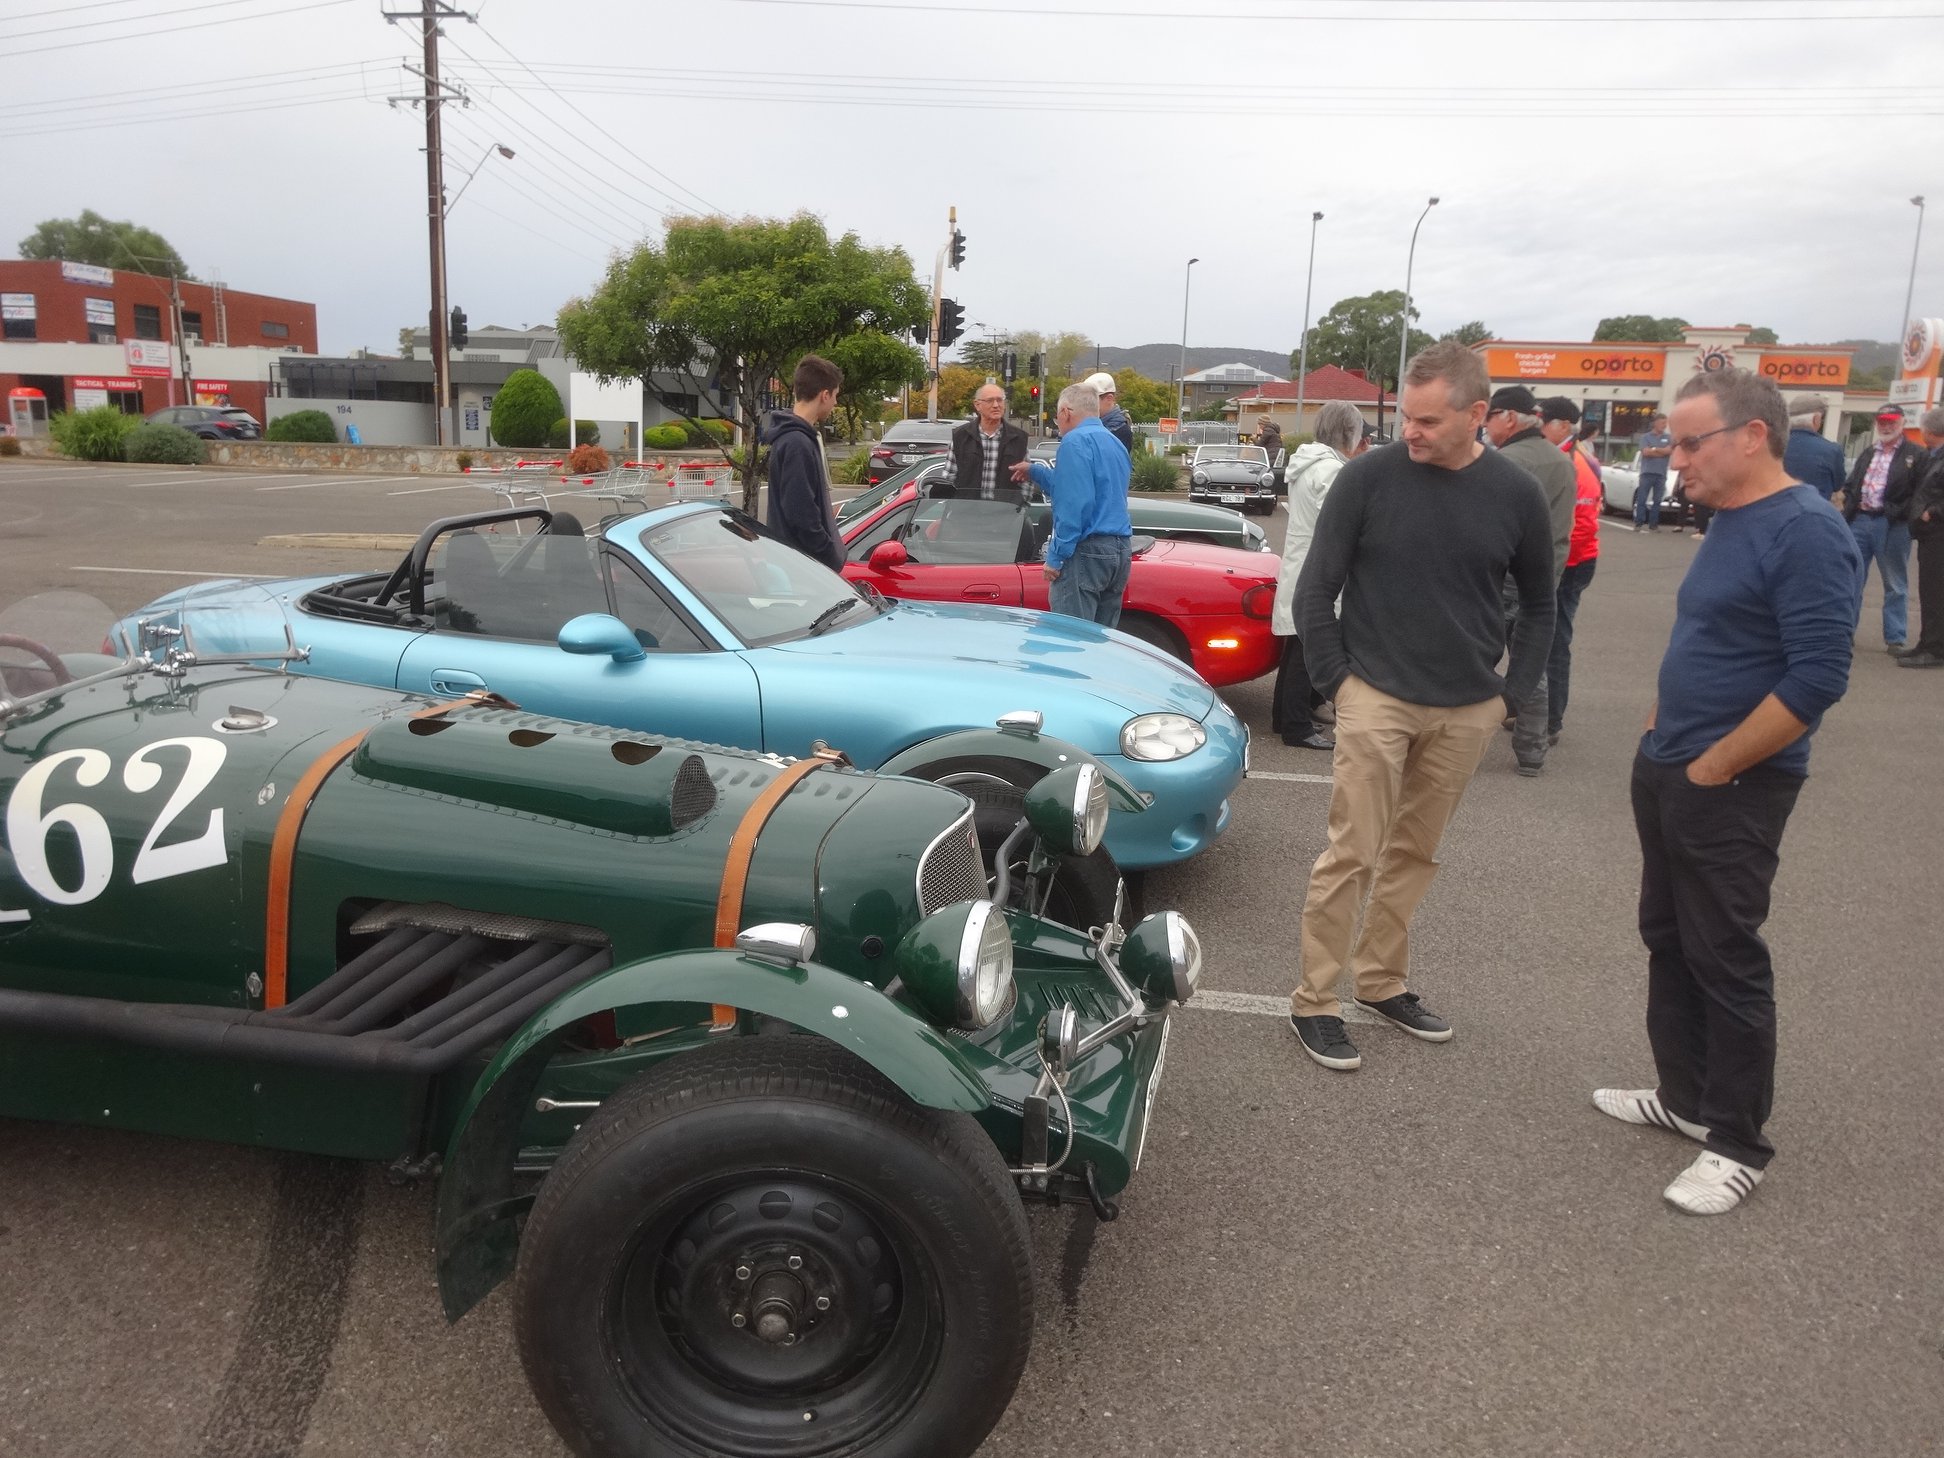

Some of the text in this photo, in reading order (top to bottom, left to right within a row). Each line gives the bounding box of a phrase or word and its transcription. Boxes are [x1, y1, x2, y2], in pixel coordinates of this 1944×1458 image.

[1520, 366, 1547, 374] burgers
[1580, 357, 1653, 375] oporto
[1764, 361, 1840, 379] oporto
[75, 379, 105, 387] TACTICAL
[107, 380, 137, 388] TRAINING
[197, 382, 228, 391] FIRE SAFETY
[337, 405, 352, 414] 194
[0, 737, 228, 922] 62
